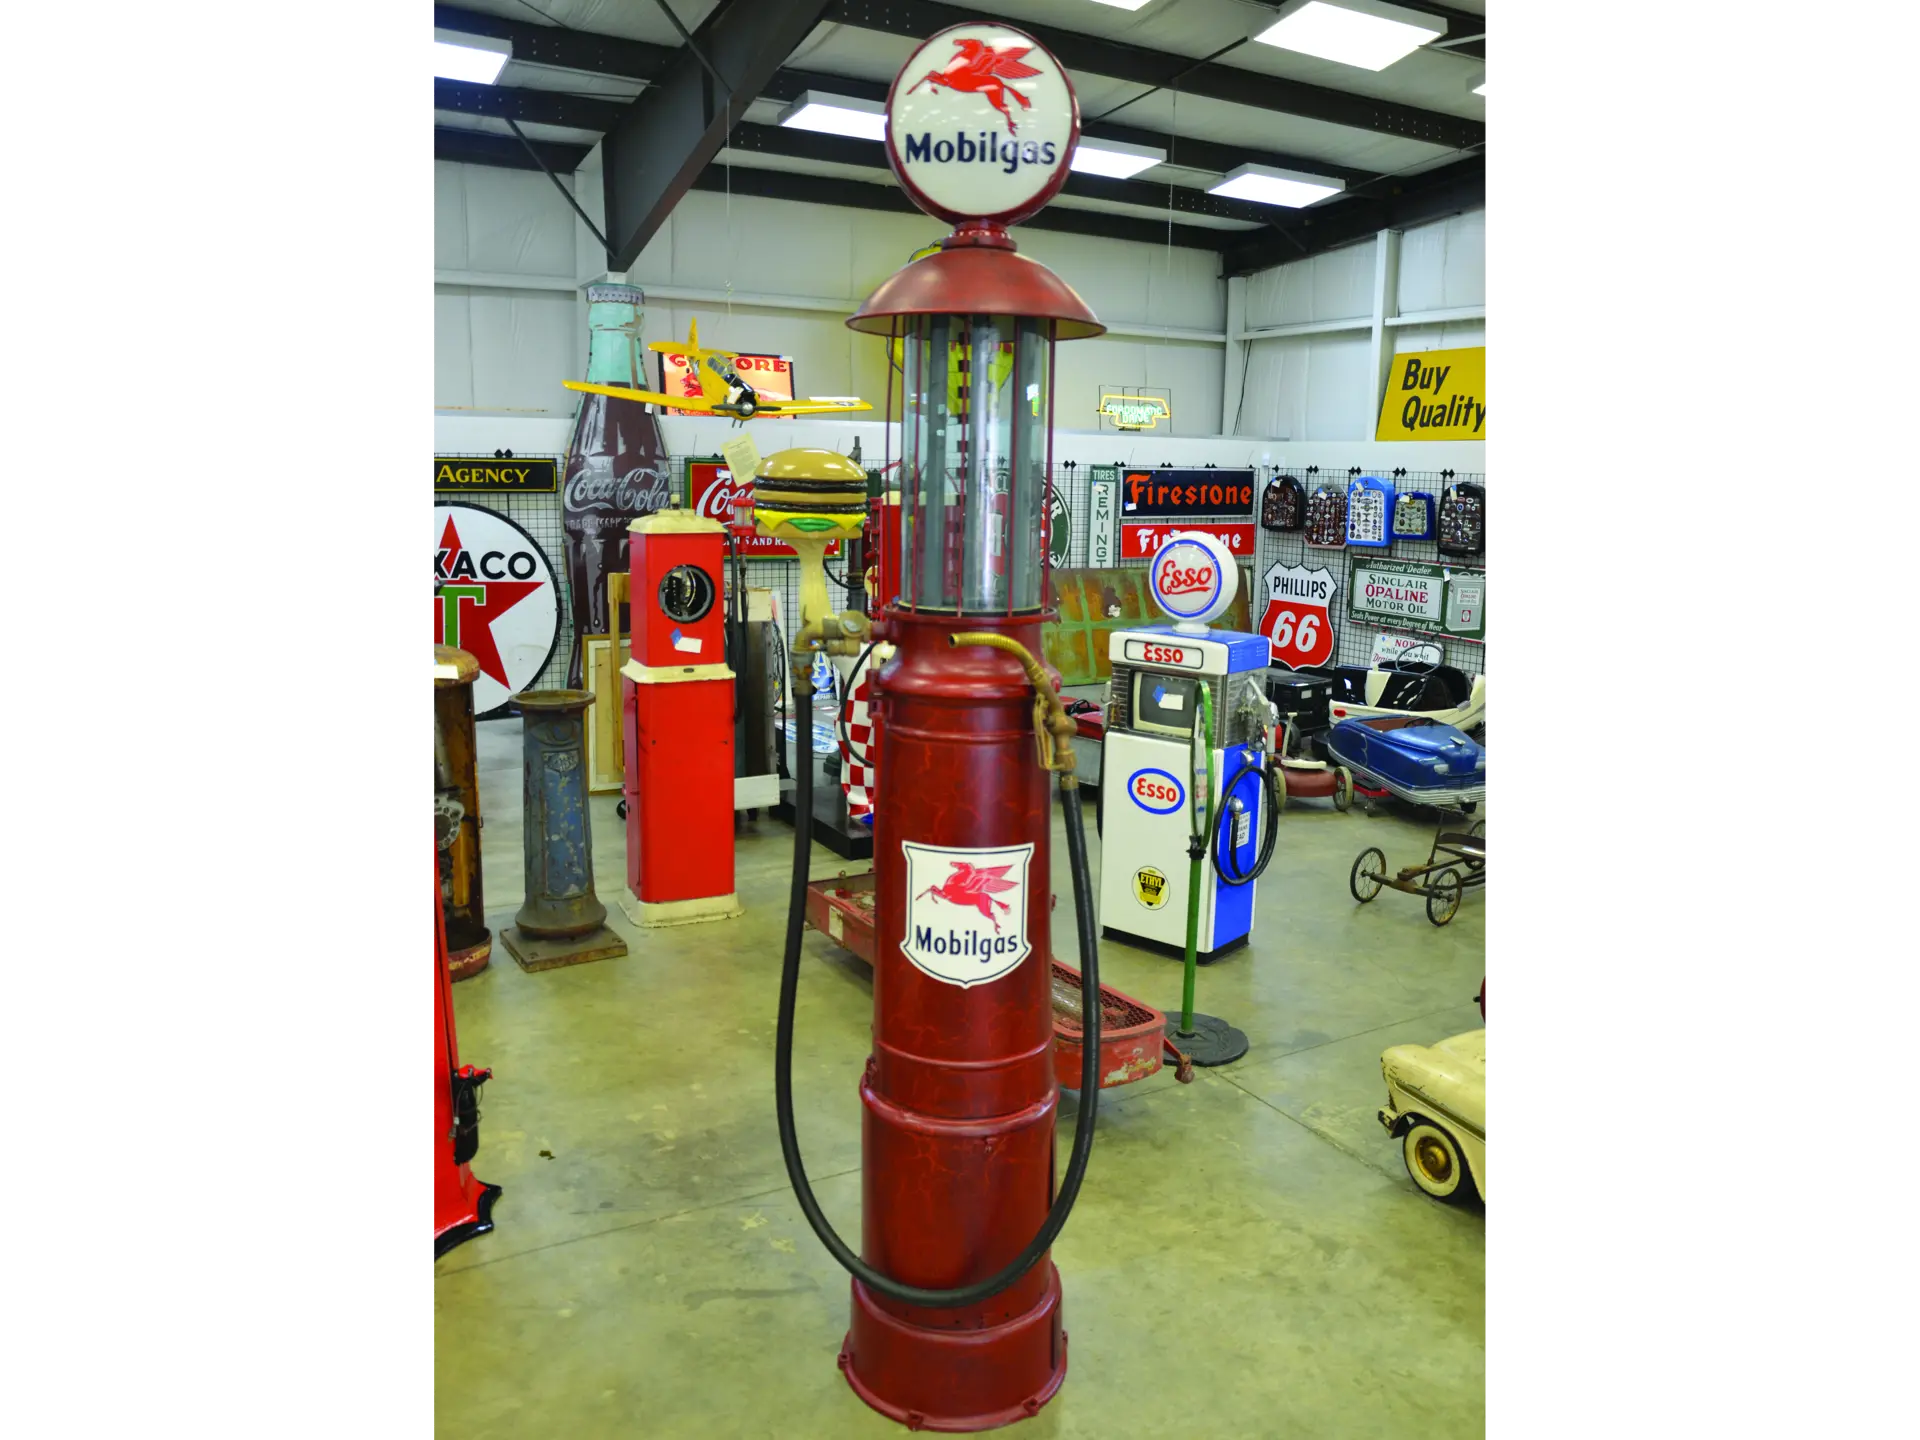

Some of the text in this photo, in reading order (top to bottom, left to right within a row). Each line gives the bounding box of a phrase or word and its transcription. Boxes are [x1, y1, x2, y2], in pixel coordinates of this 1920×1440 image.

[905, 131, 1056, 174] Mobilgas
[1402, 358, 1451, 395] Buy
[1402, 394, 1487, 433] Quality
[436, 464, 530, 483] AGENCY
[1093, 470, 1115, 480] TIRES
[1125, 474, 1252, 505] Firestone
[752, 538, 772, 546] AND
[1366, 561, 1404, 573] Authorized
[1159, 560, 1212, 595] Esso
[1273, 576, 1327, 599] PHILLIPS
[1369, 574, 1428, 590] SINCLAIR
[1365, 584, 1429, 604] OPALINE
[1366, 597, 1427, 614] MOTOR OIL
[1271, 610, 1320, 653] 66
[1364, 612, 1380, 621] Power
[1387, 617, 1402, 627] every
[1402, 618, 1421, 630] Degree
[1428, 623, 1443, 632] Wear
[1140, 873, 1162, 887] ETHYL
[915, 924, 1018, 963] Mobilgas
